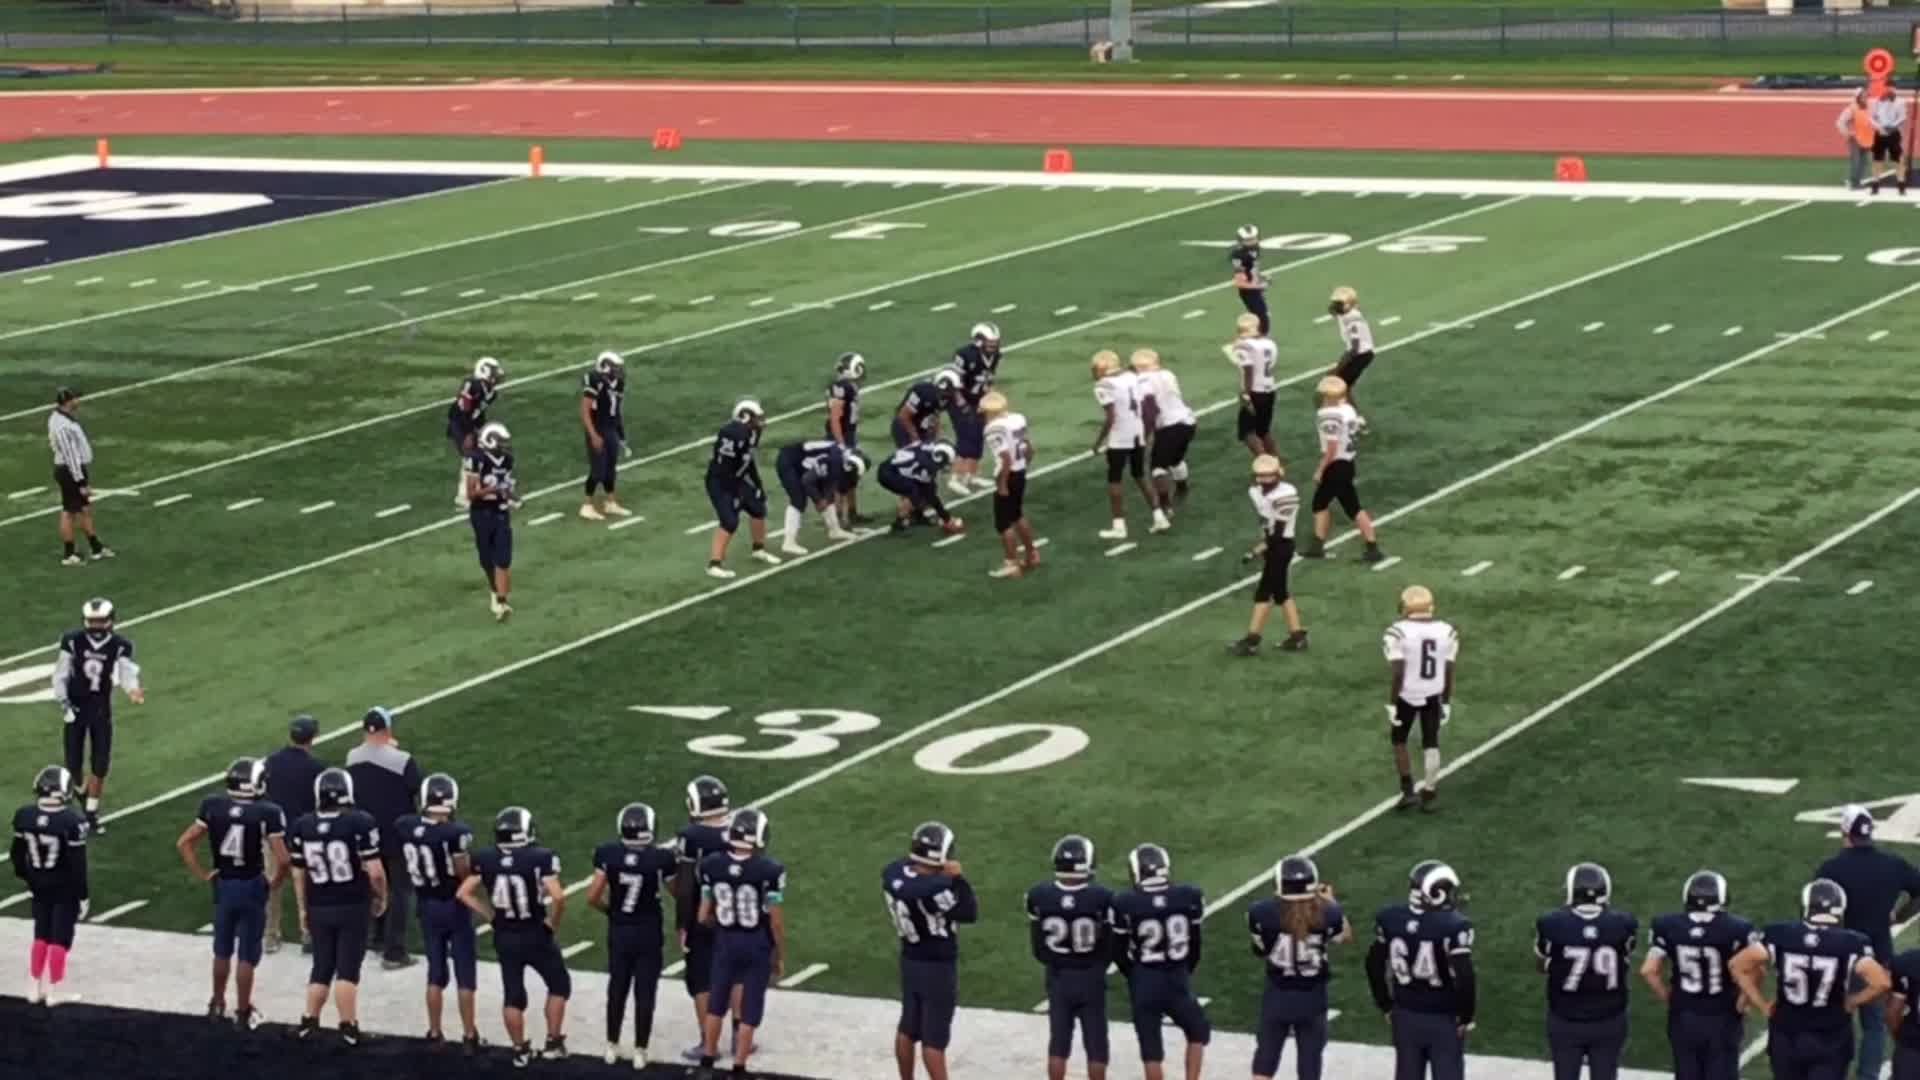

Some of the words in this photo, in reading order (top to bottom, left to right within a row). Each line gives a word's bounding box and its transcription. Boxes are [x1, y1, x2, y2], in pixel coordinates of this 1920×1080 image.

[83, 659, 104, 691] 9
[1420, 638, 1437, 680] 6
[686, 708, 1091, 775] 30
[24, 831, 60, 869] 17
[220, 823, 246, 867] 4
[303, 840, 353, 884] 58
[403, 843, 440, 887] 81
[492, 873, 532, 920] 41
[619, 873, 643, 913] 7
[1042, 916, 1097, 954] 20
[1269, 932, 1322, 977] 45
[1389, 936, 1442, 987] 64
[1562, 945, 1619, 991] 79
[1676, 944, 1723, 994] 51
[1783, 952, 1838, 1007] 57
